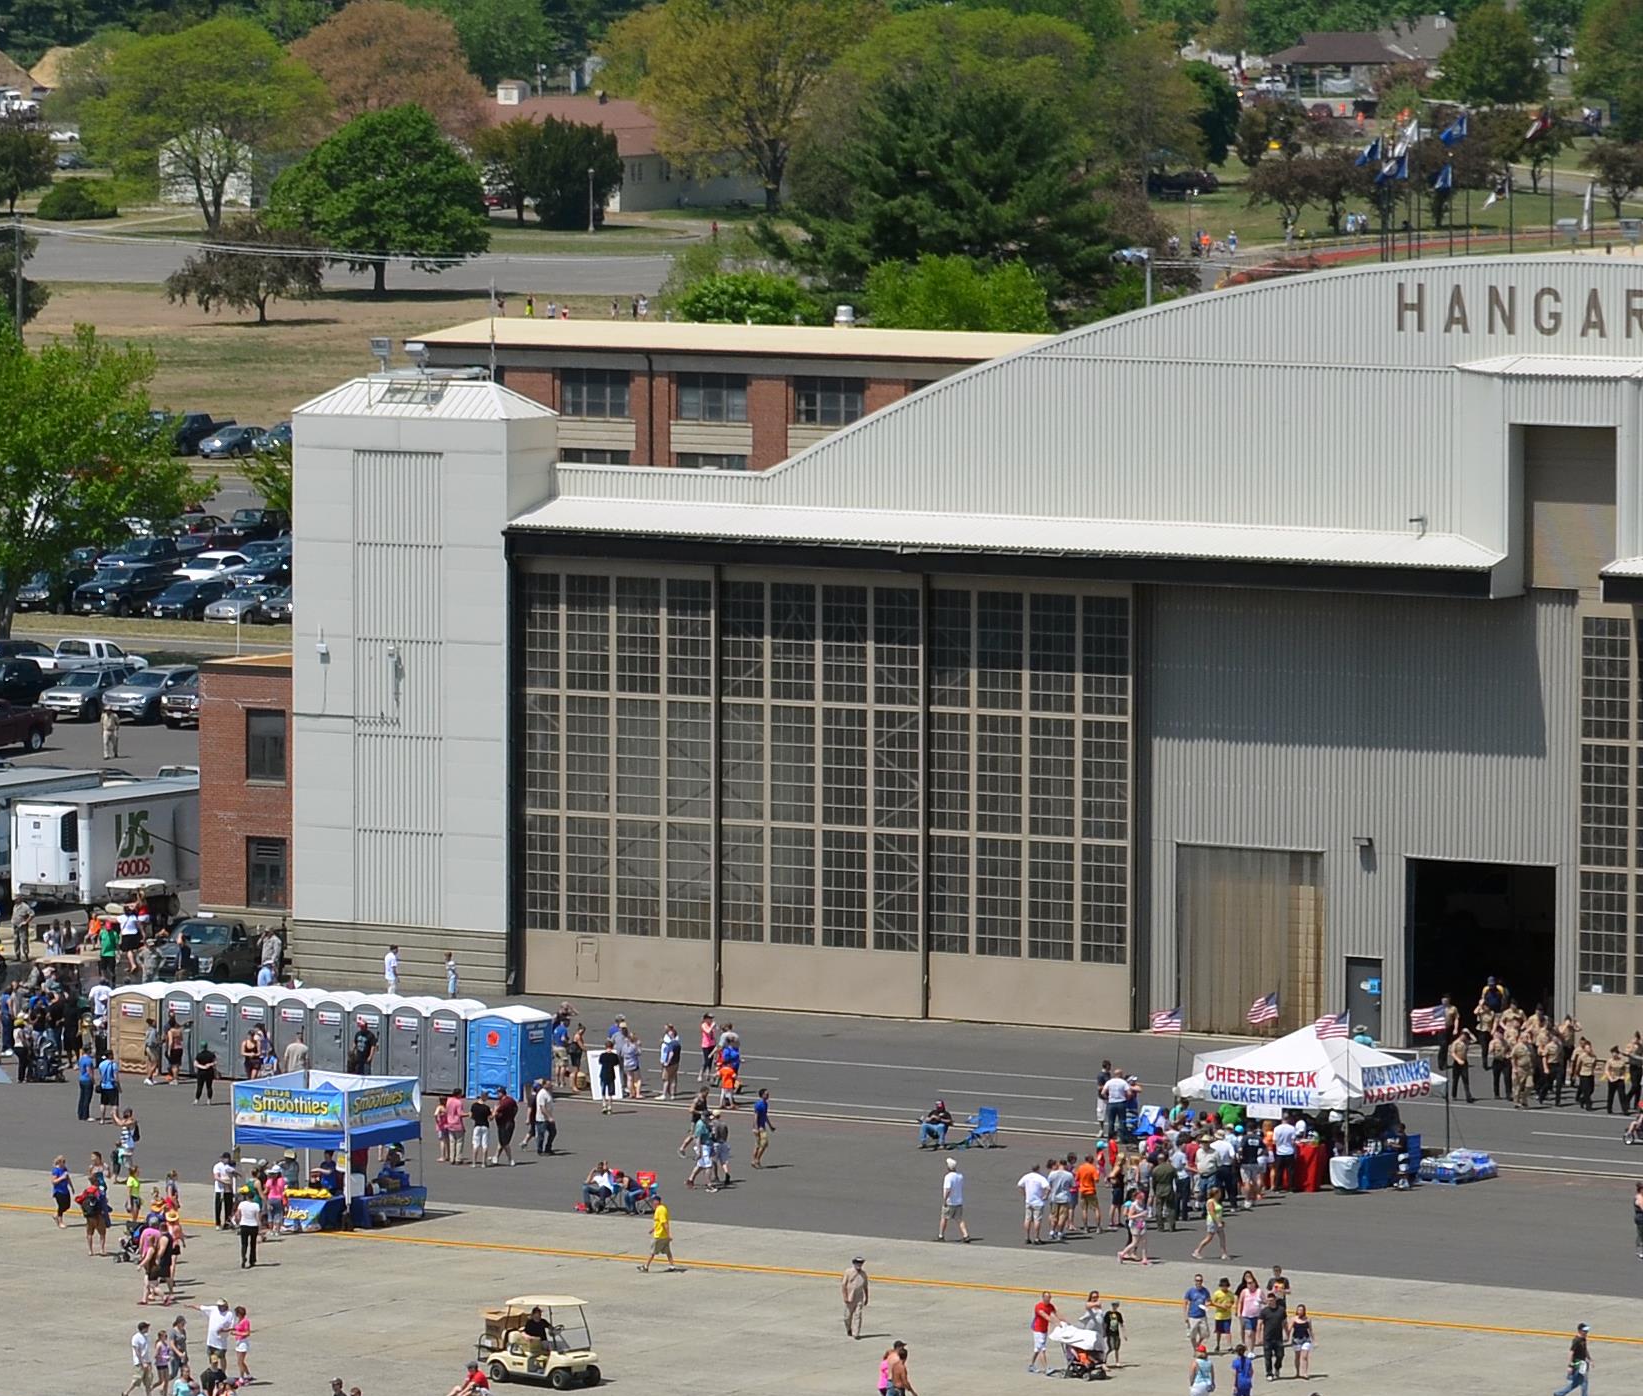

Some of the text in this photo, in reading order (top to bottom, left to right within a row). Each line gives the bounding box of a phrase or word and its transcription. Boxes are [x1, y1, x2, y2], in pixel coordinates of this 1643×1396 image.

[1396, 281, 1643, 340] HANGAR
[115, 857, 151, 877] FOODS
[1205, 1064, 1319, 1089] CHEESESTEAK
[1387, 1059, 1431, 1085] DRINKS
[252, 1094, 330, 1115] Smoothies
[353, 1090, 404, 1114] Smoothies
[1210, 1085, 1312, 1107] CHICKEN PHILLY
[1363, 1081, 1431, 1105] NACHOS
